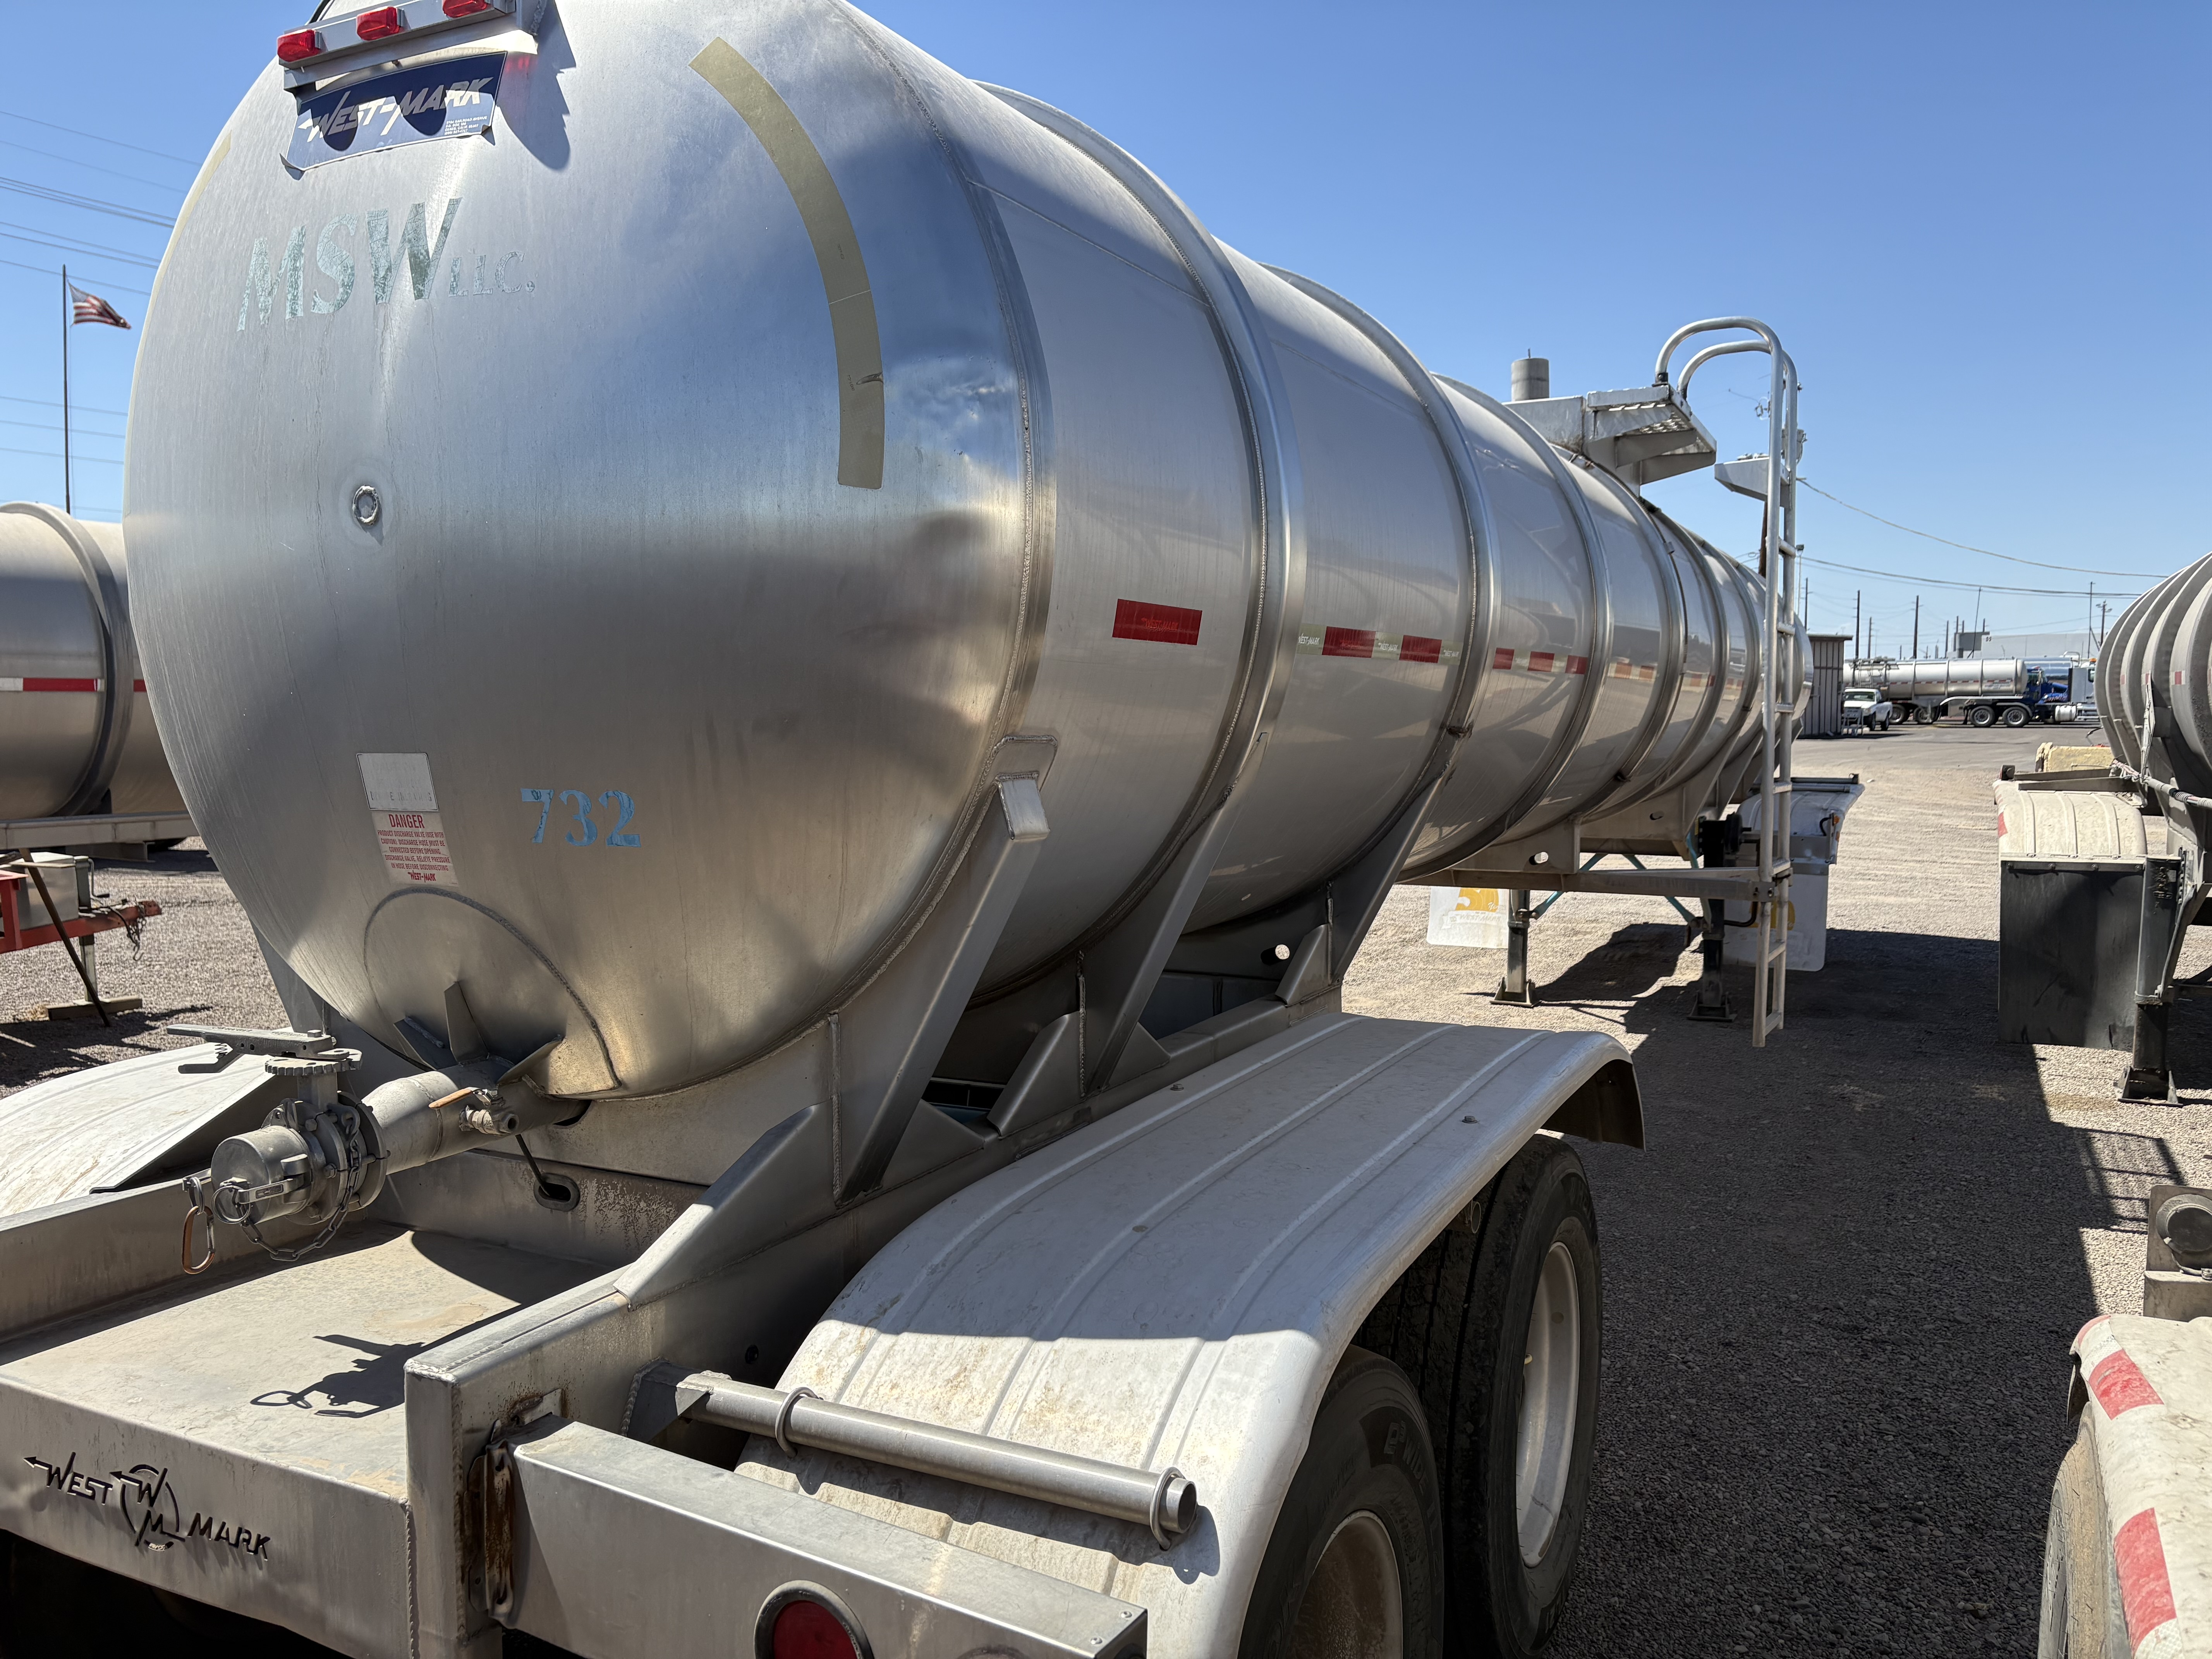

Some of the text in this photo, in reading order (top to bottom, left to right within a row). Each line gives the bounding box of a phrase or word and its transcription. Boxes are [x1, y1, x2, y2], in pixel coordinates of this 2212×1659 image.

[303, 77, 493, 142] WEST-MARK
[237, 197, 462, 331] MSW
[388, 814, 425, 828] DANGER
[520, 788, 641, 847] 732
[409, 870, 436, 883] WEST-MARK
[43, 1452, 113, 1505] WEST
[187, 1512, 271, 1561] MARK
